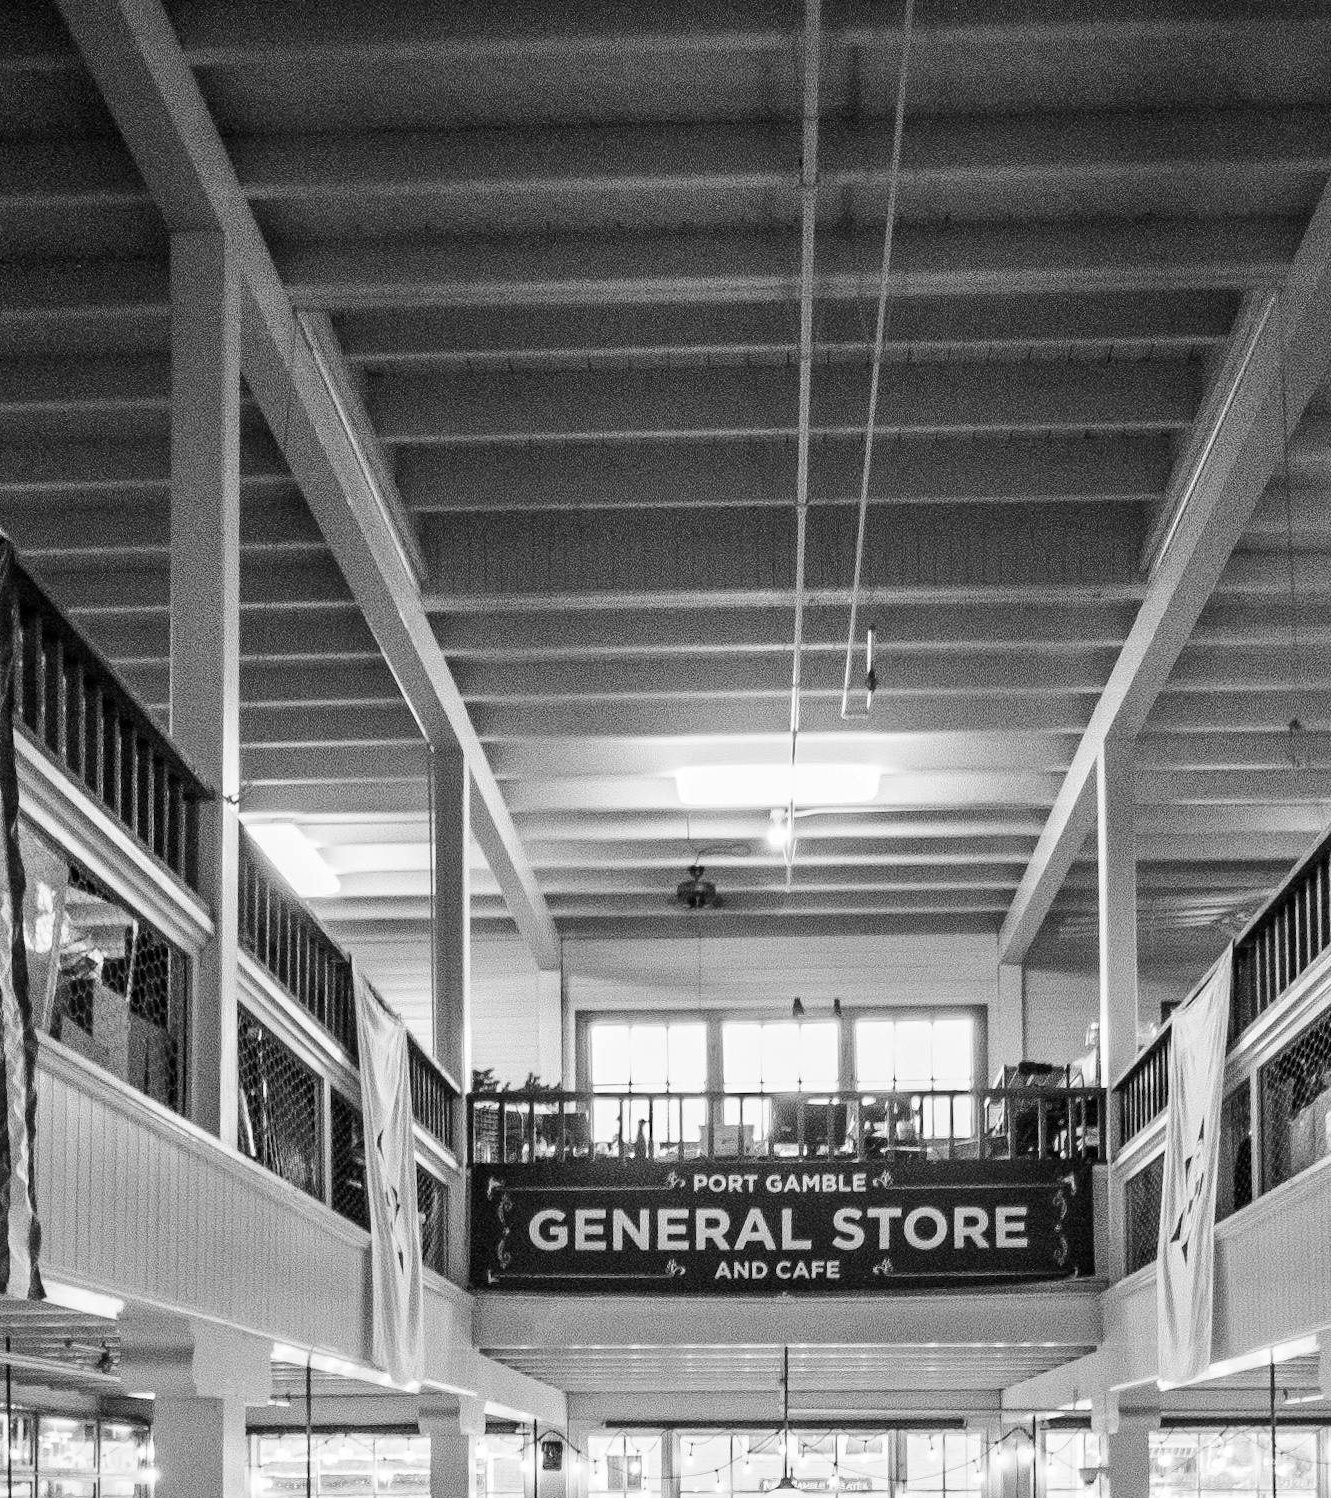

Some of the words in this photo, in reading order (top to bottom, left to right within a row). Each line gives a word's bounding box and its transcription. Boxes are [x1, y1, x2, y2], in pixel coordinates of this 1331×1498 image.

[694, 1173, 759, 1193] PORT
[766, 1173, 867, 1193] GAMBLE
[529, 1207, 812, 1251] GENERAL
[833, 1207, 1028, 1251] STORE
[716, 1261, 768, 1279] AND
[776, 1261, 840, 1279] CAFE
